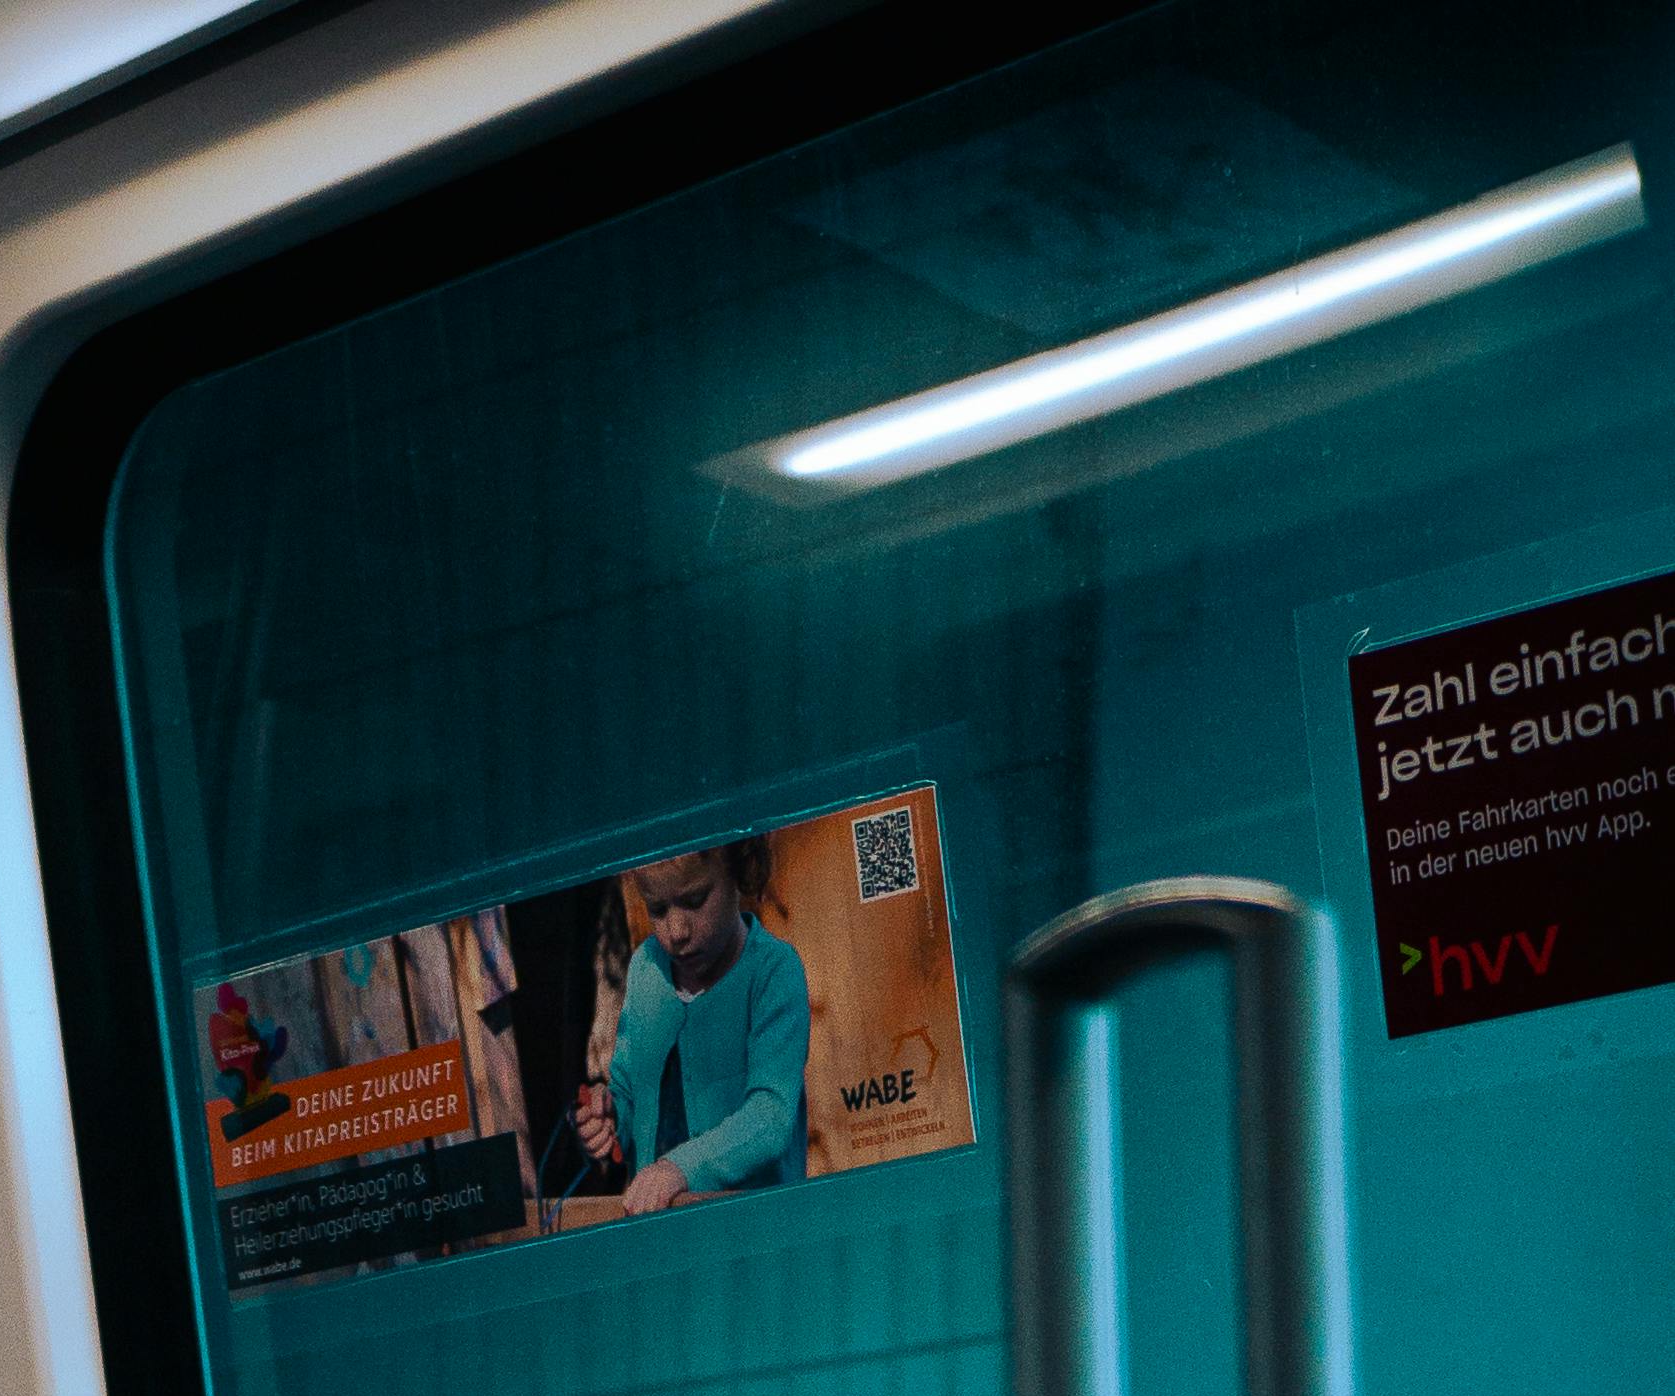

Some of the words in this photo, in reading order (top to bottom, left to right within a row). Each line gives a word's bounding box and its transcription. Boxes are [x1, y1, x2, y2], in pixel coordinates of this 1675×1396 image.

[1373, 662, 1476, 727] Zahl
[1489, 613, 1675, 696] einfach
[1377, 722, 1500, 801] jetzt
[1509, 689, 1640, 755] auch
[1386, 819, 1451, 851] Deine
[1458, 785, 1589, 834] Fahrkarten
[1596, 766, 1658, 801] noch
[1389, 860, 1412, 886] in
[1418, 853, 1458, 880] der
[1464, 834, 1539, 869] neuen
[1545, 823, 1589, 850] hvv
[1595, 809, 1652, 841] App.
[1428, 923, 1561, 998] hvv
[295, 1084, 354, 1118] DEINE
[361, 1059, 455, 1102] ZUKUNFT
[840, 1069, 917, 1113] WABE
[231, 1138, 276, 1168] BEIM
[284, 1093, 459, 1155] KITAPREISTRÄGER
[412, 1163, 428, 1186] &
[422, 1183, 485, 1222] gesucht
